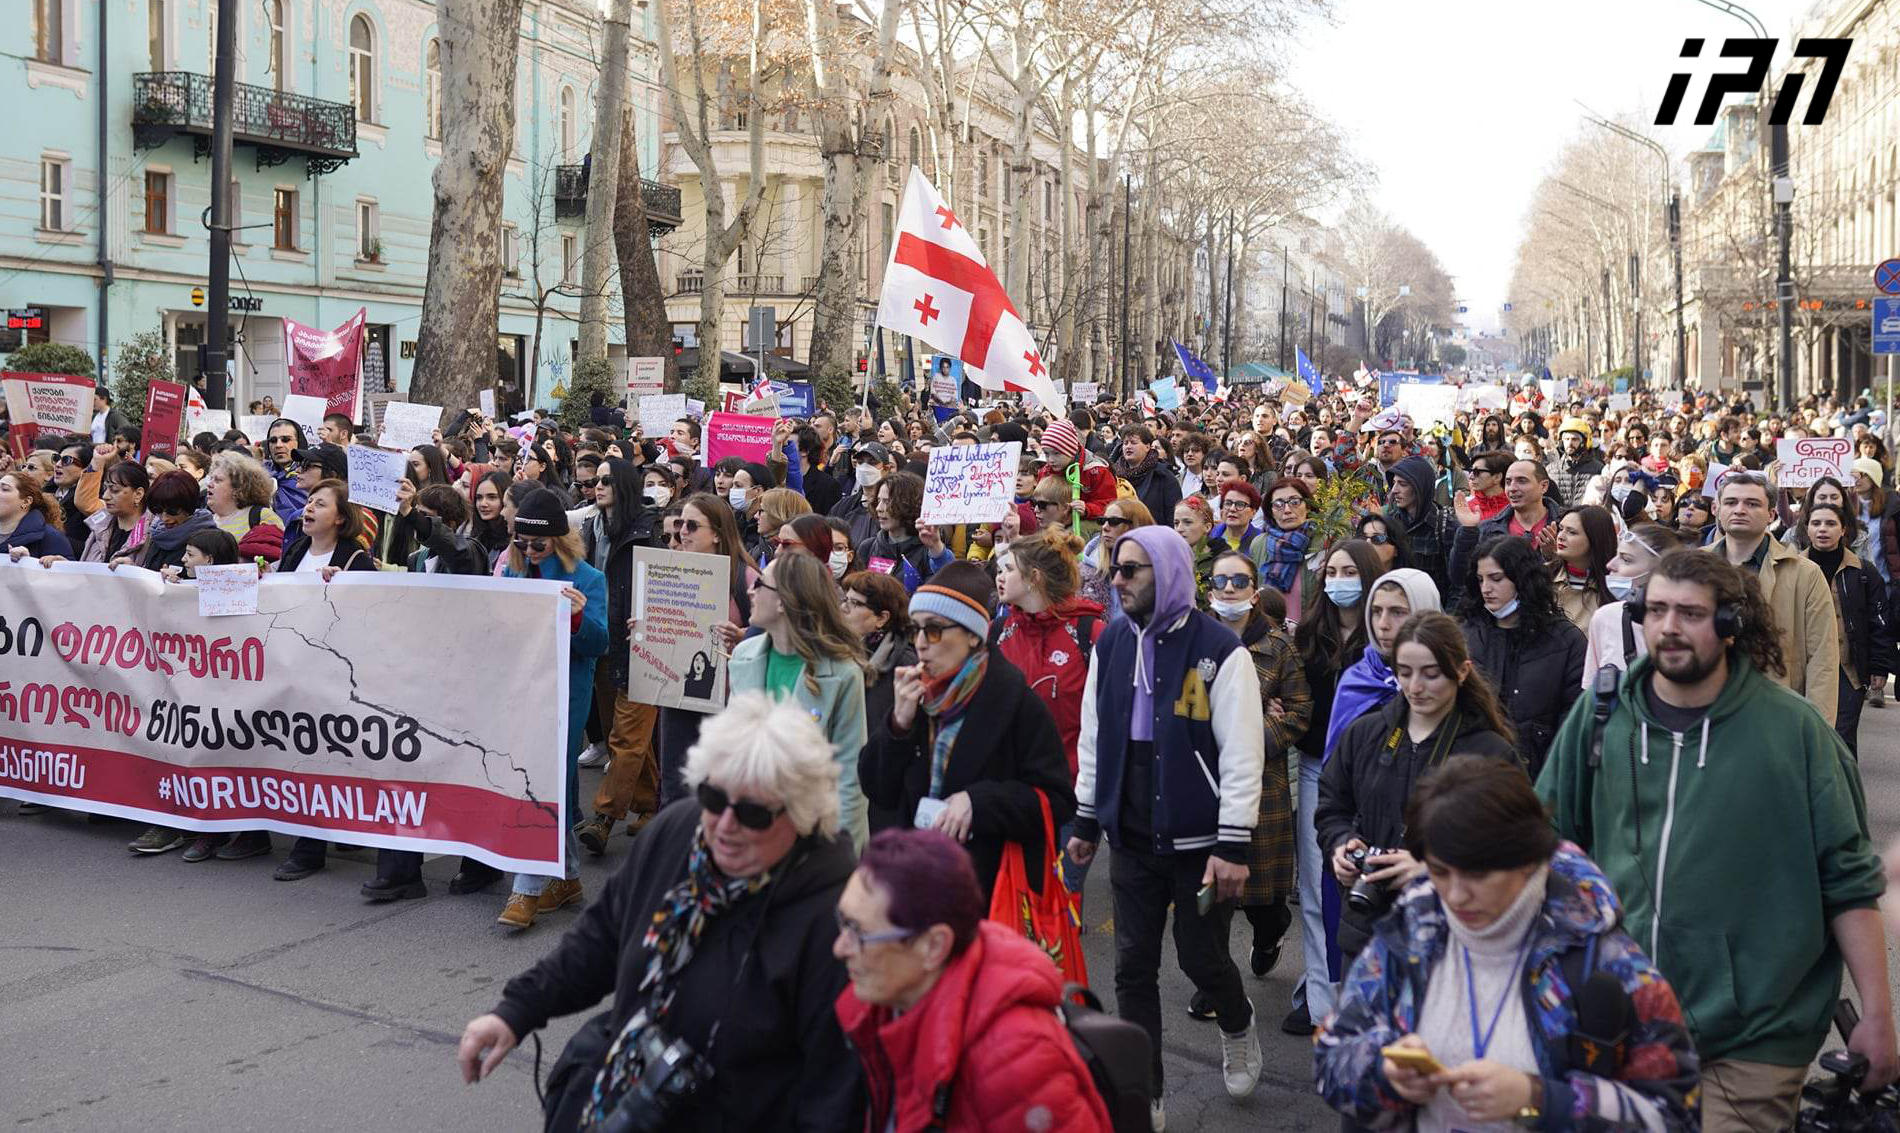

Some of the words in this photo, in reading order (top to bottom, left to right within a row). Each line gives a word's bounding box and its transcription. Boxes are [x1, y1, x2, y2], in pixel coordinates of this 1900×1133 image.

[1797, 466, 1835, 479] GIPA
[51, 622, 265, 682] ტოტალური
[1173, 667, 1210, 721] A
[146, 699, 422, 763] წინააღმდეგ
[0, 744, 86, 789] კანონს
[159, 773, 428, 827] #NORUSSIANLAW
